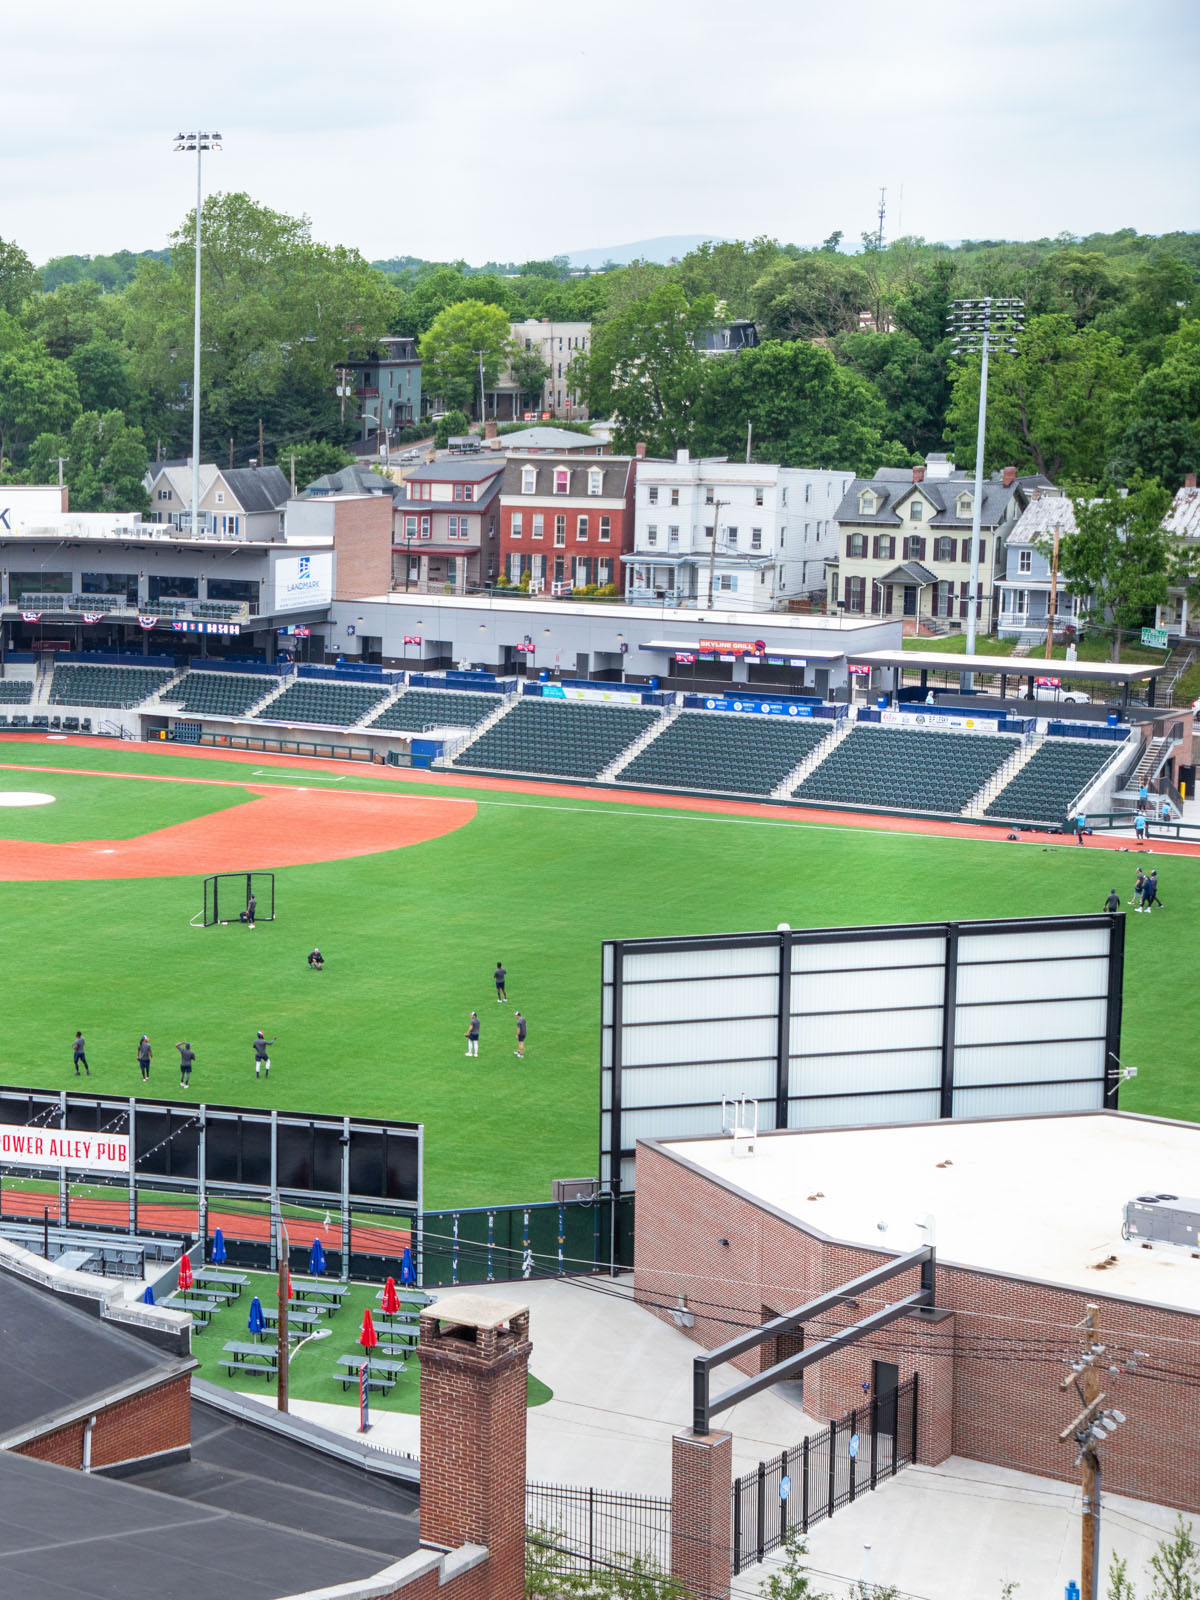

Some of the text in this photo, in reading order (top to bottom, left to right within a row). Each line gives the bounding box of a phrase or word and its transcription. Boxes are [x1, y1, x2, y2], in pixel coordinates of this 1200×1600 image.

[287, 580, 320, 592] LANDMARK
[50, 1138, 91, 1159] ALLEY
[97, 1143, 127, 1162] PUB
